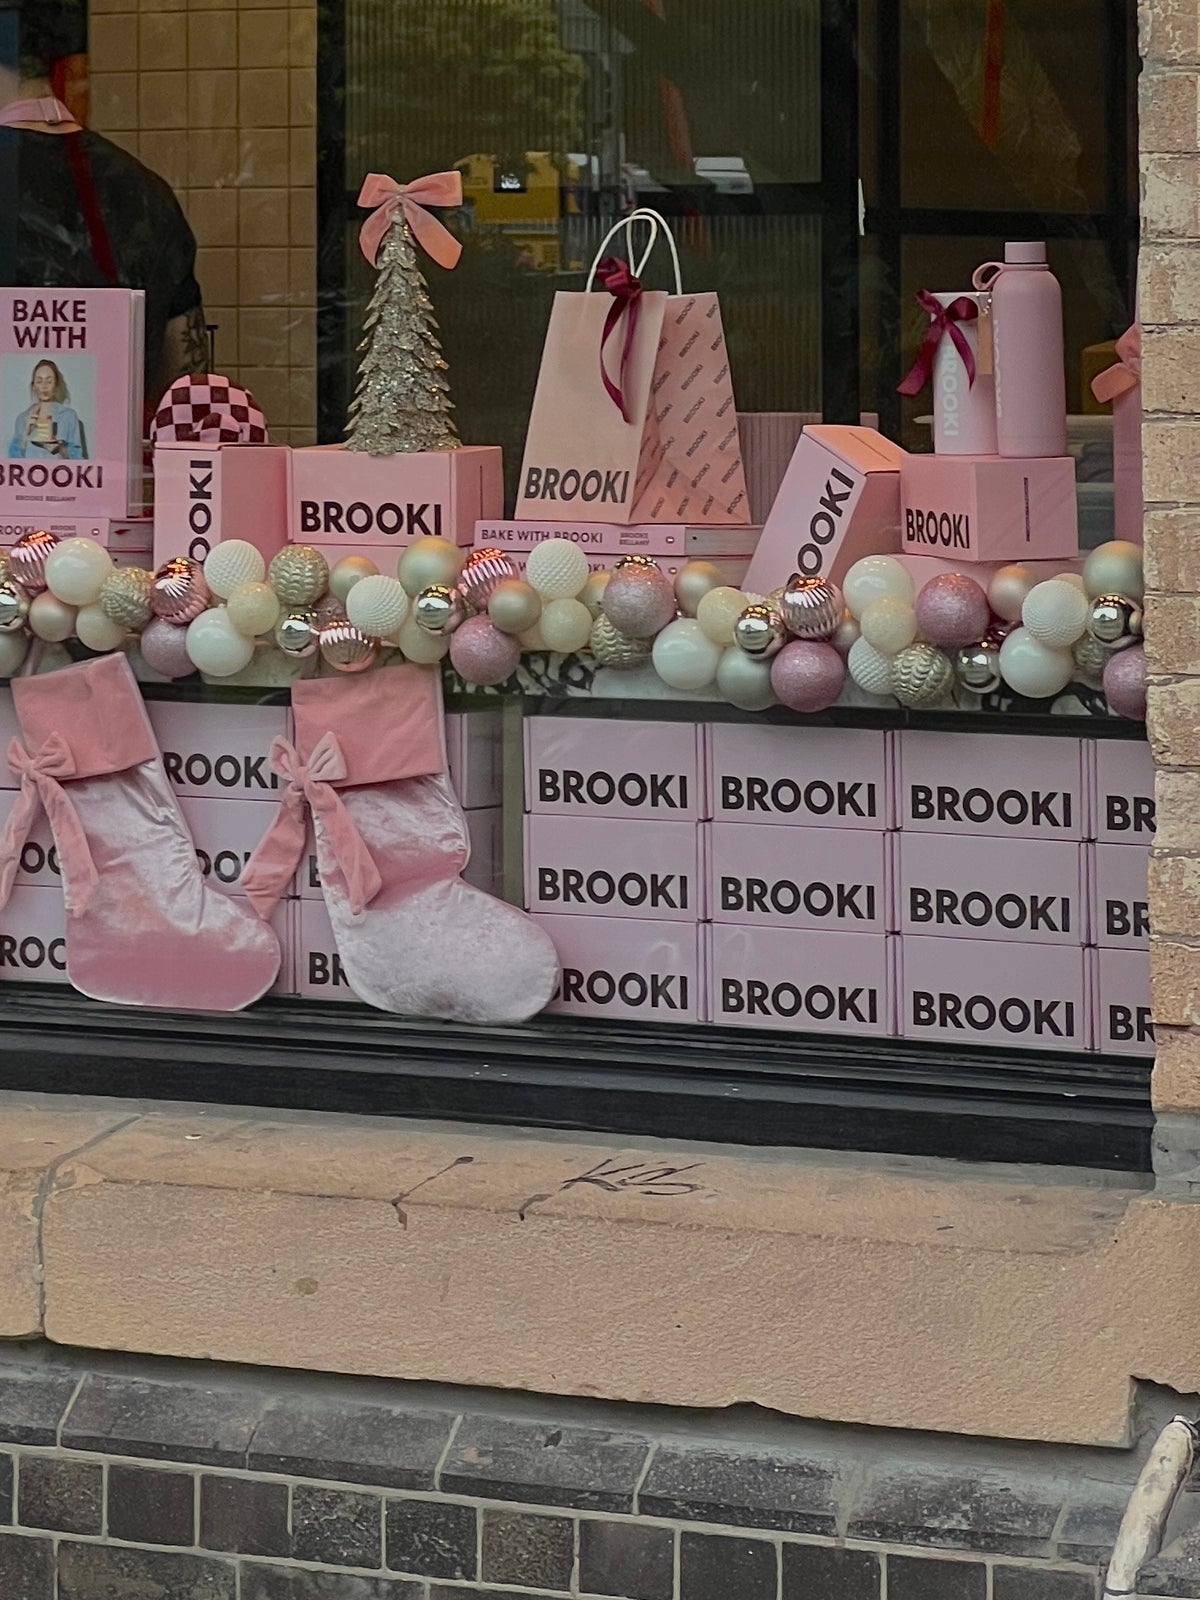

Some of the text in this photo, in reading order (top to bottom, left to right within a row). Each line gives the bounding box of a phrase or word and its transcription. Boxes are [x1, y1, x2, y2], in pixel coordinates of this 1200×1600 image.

[12, 299, 87, 322] BAKE
[12, 326, 87, 349] WITH
[524, 466, 630, 503] BROOKI
[189, 460, 212, 565] OOKI
[301, 501, 442, 536] BROOKI
[788, 467, 855, 584] OOKI
[906, 508, 970, 549] BROOKI
[481, 530, 513, 541] BAKE
[516, 531, 550, 542] WITH
[538, 769, 688, 809] BROOKI
[721, 776, 877, 818] BROOKI
[911, 785, 1072, 828] BROOKI
[538, 868, 688, 910] BROOKI
[720, 877, 875, 920] BROOKI
[910, 887, 1070, 932] BROOKI
[552, 968, 688, 1010] ROOKI
[721, 978, 877, 1024] BROOKI
[913, 991, 1075, 1038] BROOKI
